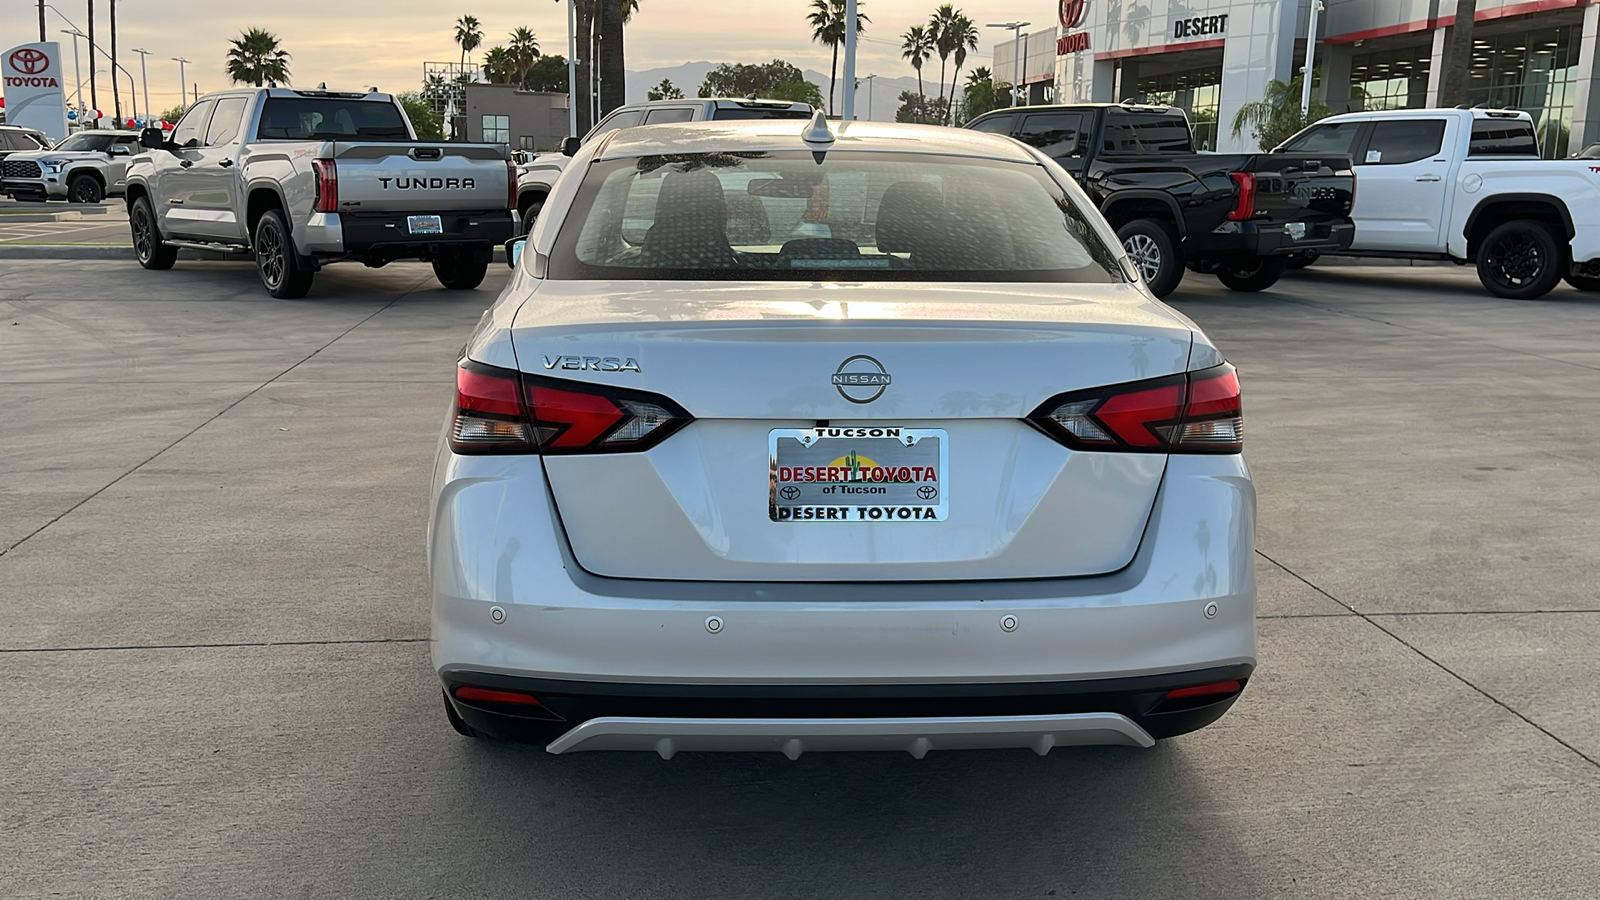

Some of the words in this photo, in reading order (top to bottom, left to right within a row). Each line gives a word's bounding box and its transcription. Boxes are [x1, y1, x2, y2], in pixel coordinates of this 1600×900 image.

[1174, 14, 1228, 38] DESERT
[1056, 32, 1088, 55] TOYOTA
[3, 76, 59, 88] TOYOTA
[378, 177, 476, 190] TUNDRA
[539, 354, 642, 373] VERSA
[832, 373, 891, 385] NISSAN
[815, 428, 901, 438] TUCSON
[779, 466, 852, 483] DESERT
[858, 466, 938, 483] TOYOTA
[822, 485, 837, 495] of
[838, 485, 887, 495] Tucson
[779, 507, 850, 520] DESERT
[857, 507, 938, 520] TOYOTA
